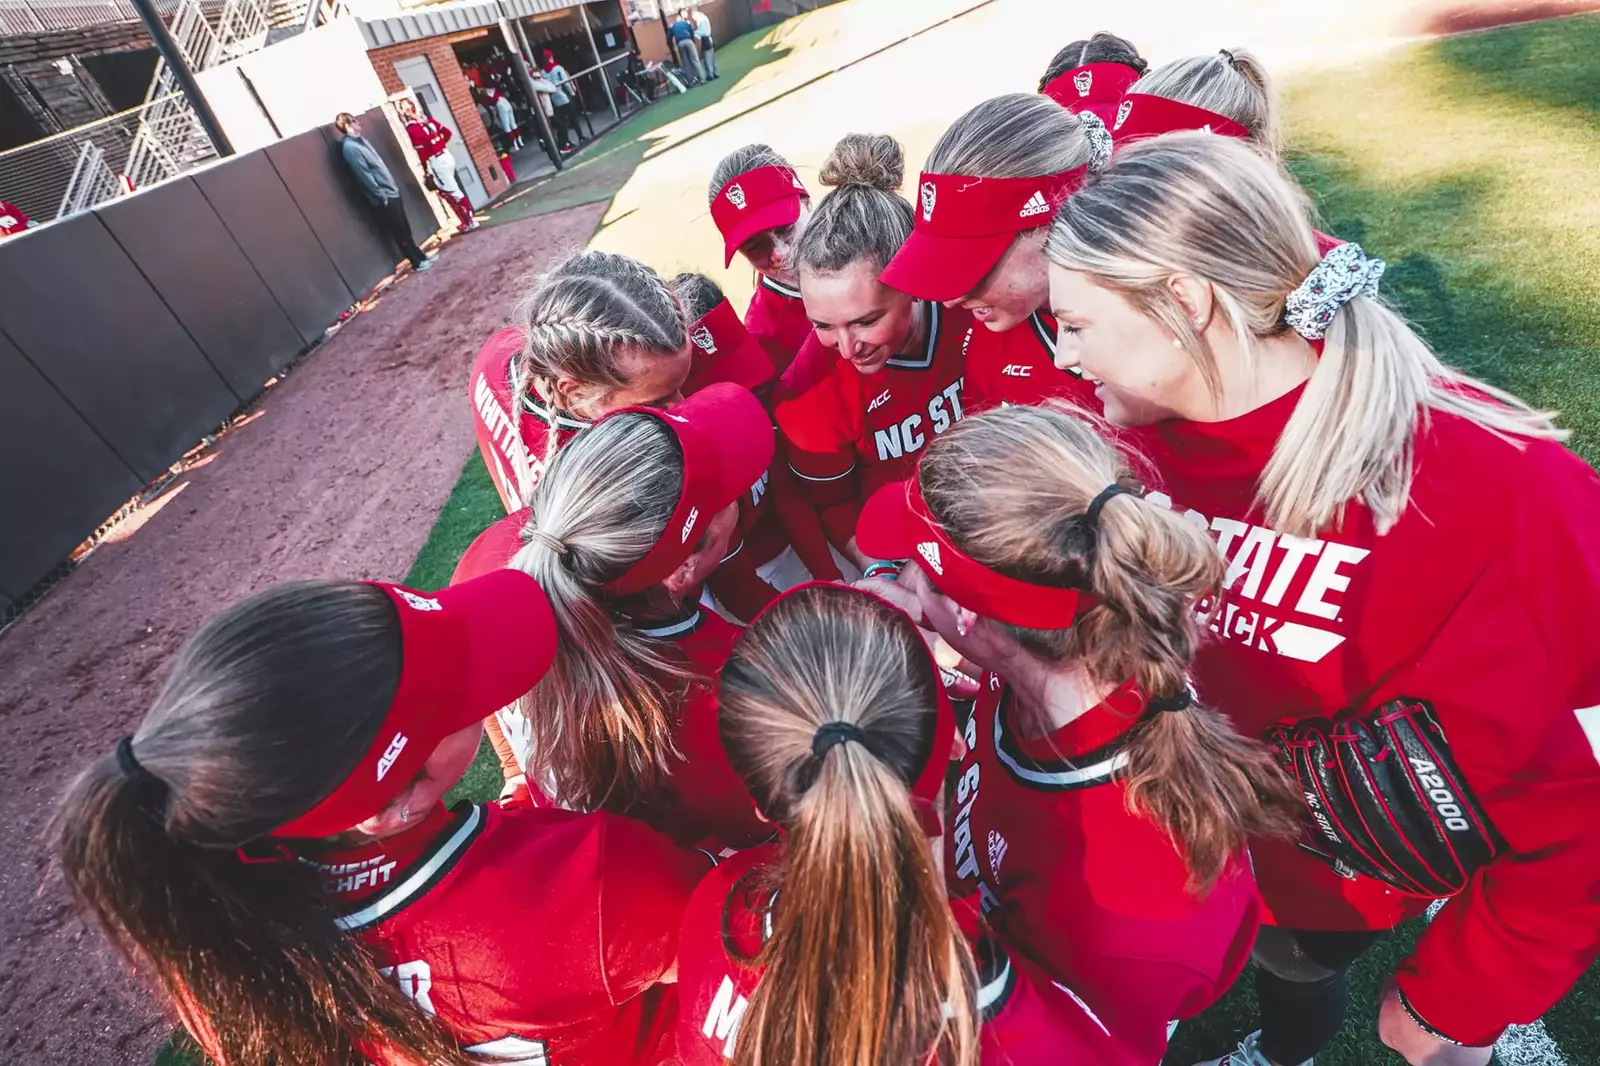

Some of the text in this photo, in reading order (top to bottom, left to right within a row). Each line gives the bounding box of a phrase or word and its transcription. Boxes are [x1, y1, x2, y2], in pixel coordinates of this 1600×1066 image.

[1019, 204, 1050, 218] adidas
[1001, 364, 1033, 377] ACC
[867, 389, 892, 413] ACC
[874, 377, 964, 461] NC ST
[681, 505, 699, 544] ACC
[377, 731, 409, 782] ACC
[1408, 757, 1470, 831] A2000
[1304, 791, 1342, 844] NC STATE
